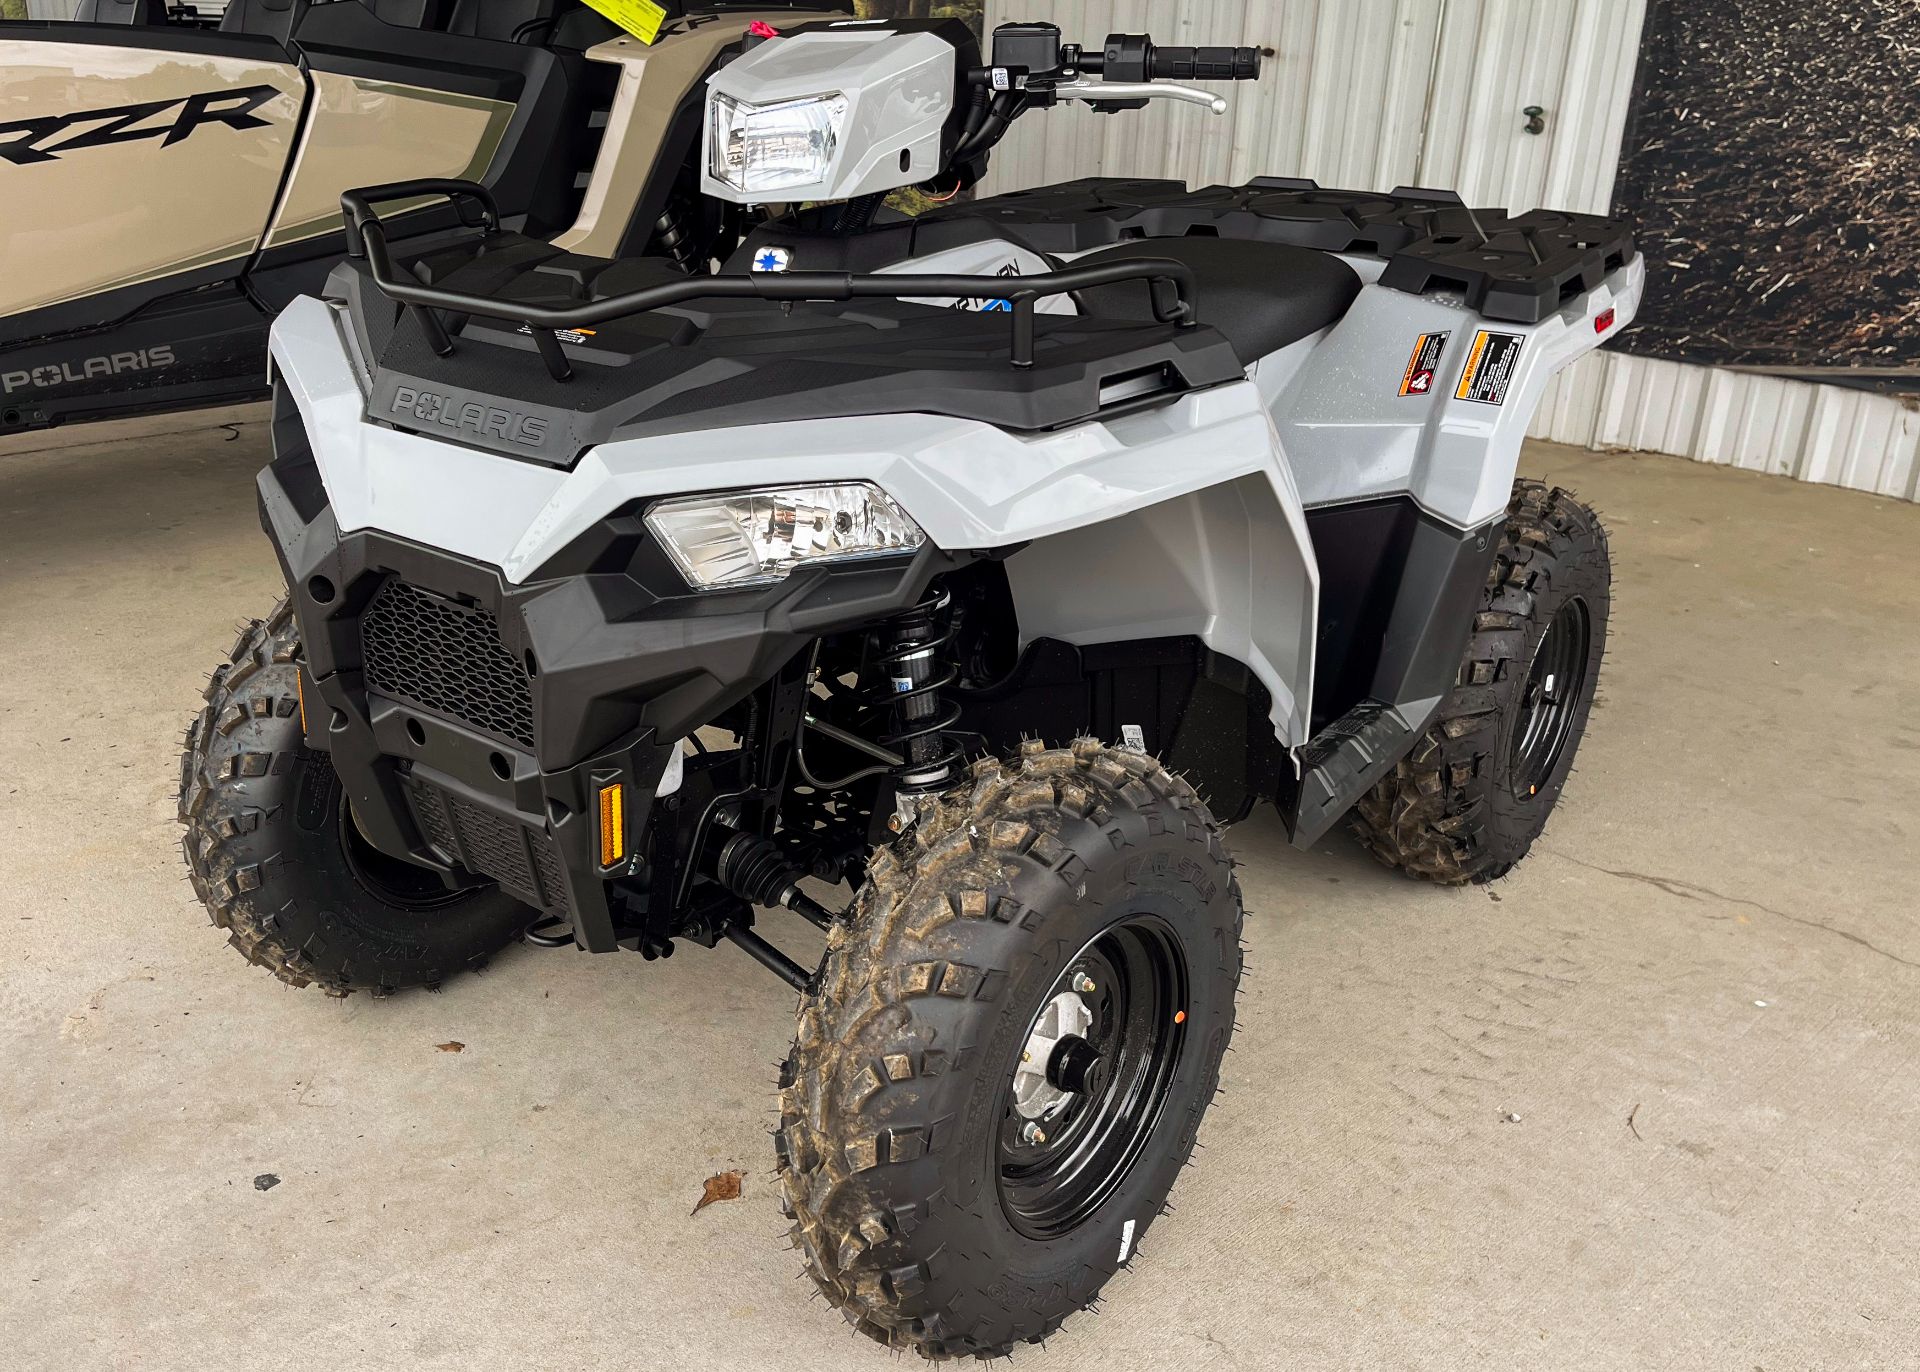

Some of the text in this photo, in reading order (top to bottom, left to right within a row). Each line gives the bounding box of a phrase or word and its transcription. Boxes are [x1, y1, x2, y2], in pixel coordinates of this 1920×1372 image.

[0, 84, 282, 165] RZR
[1, 345, 175, 393] POLARIS
[1466, 347, 1481, 376] WARNING
[390, 386, 549, 447] POLARIS
